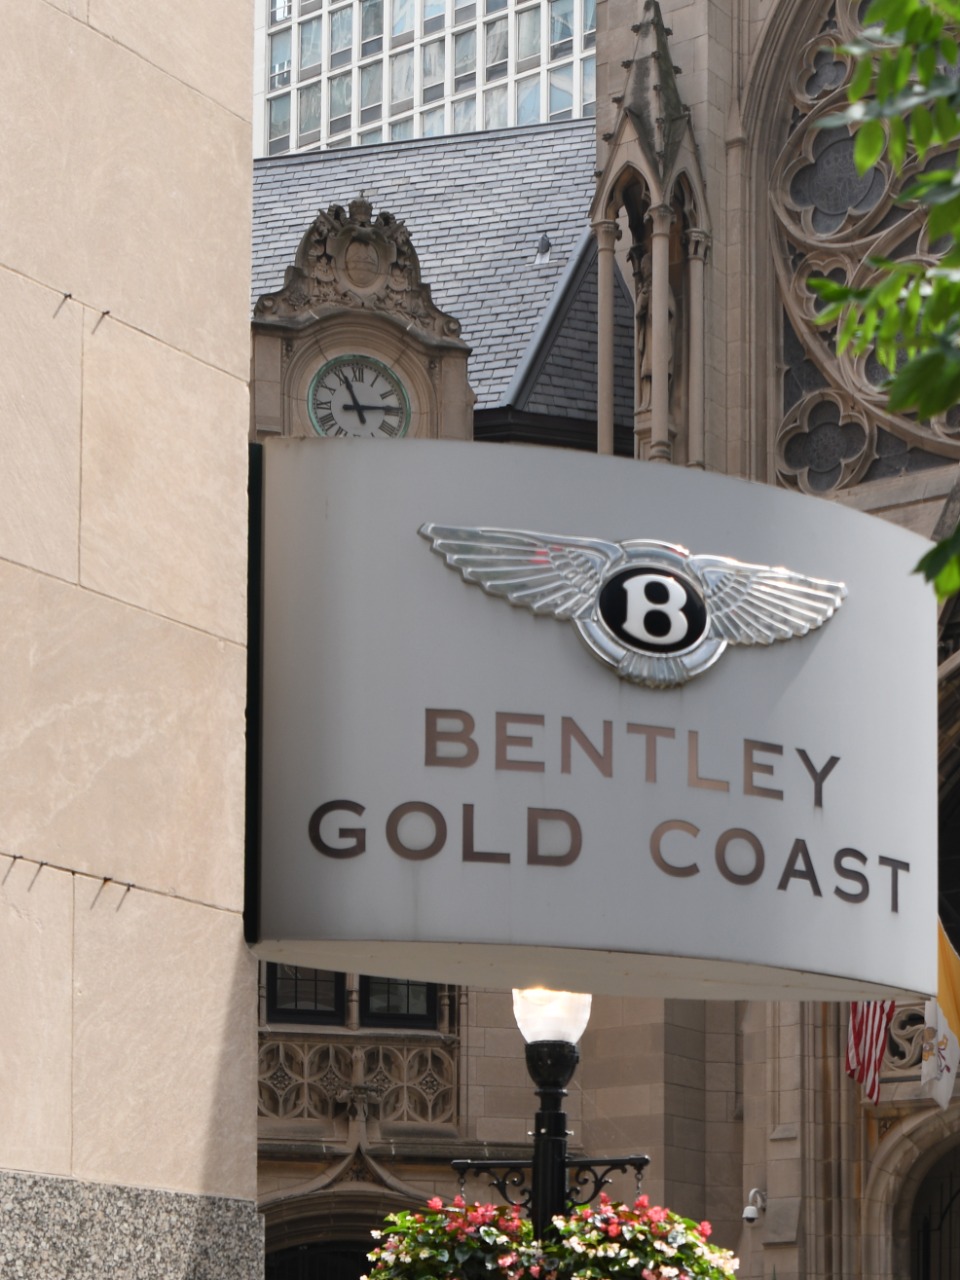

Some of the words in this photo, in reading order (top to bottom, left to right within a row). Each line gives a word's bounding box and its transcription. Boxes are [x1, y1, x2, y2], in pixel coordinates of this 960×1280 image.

[620, 574, 688, 645] B
[423, 707, 841, 809] BENTLEY
[308, 799, 583, 867] GOLD
[649, 819, 911, 914] COAST
